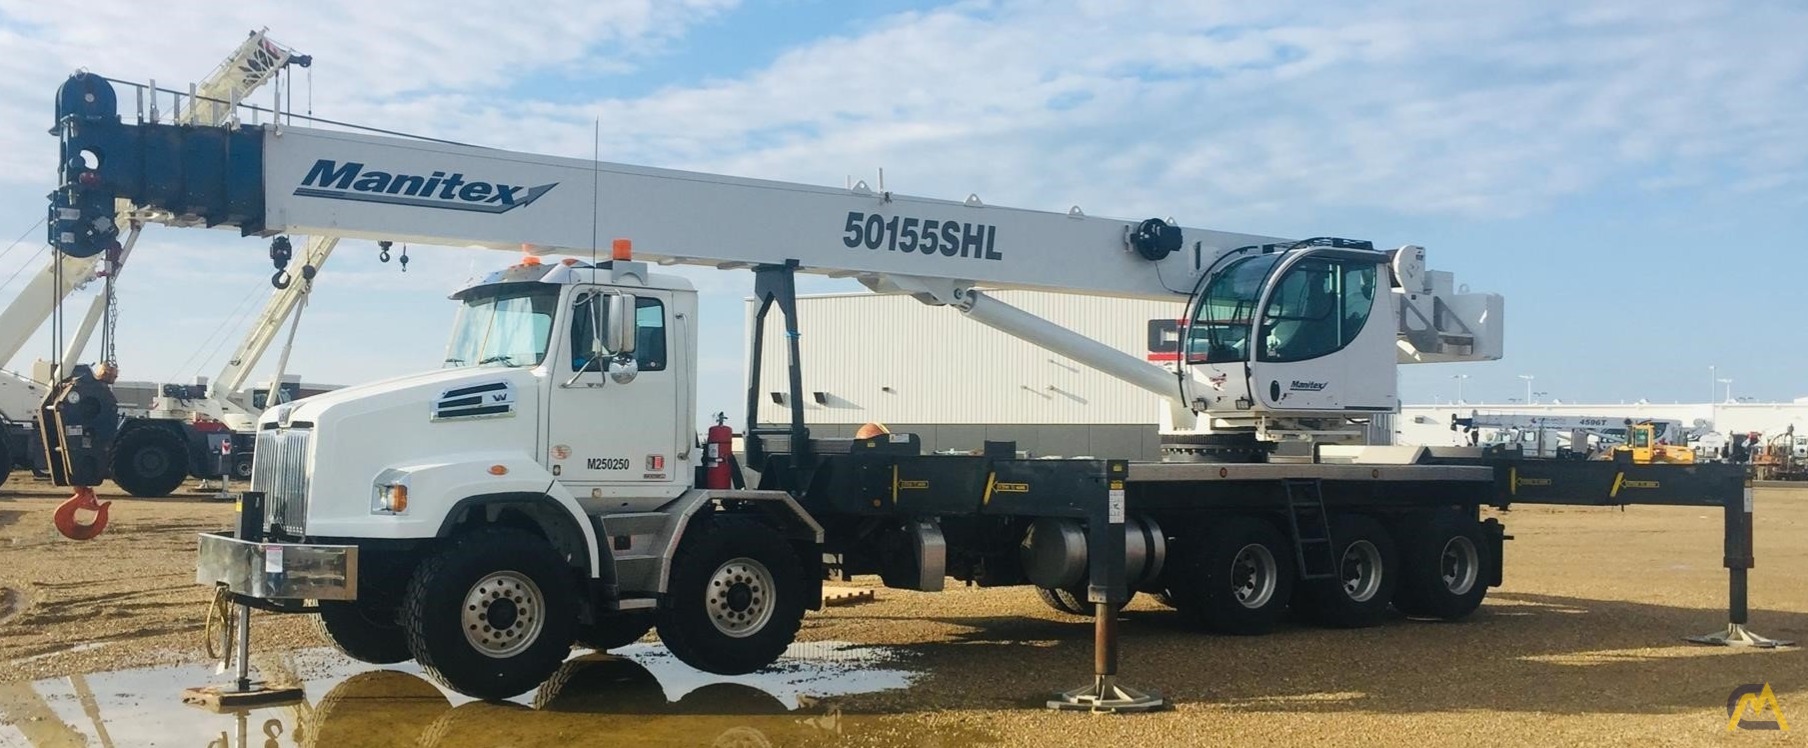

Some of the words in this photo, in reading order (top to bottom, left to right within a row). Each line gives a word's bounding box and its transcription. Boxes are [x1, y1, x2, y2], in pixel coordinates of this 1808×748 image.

[301, 159, 523, 205] Manitex
[843, 211, 1002, 261] 50155SHL
[1290, 380, 1325, 390] Manitex
[587, 458, 630, 470] M250250
